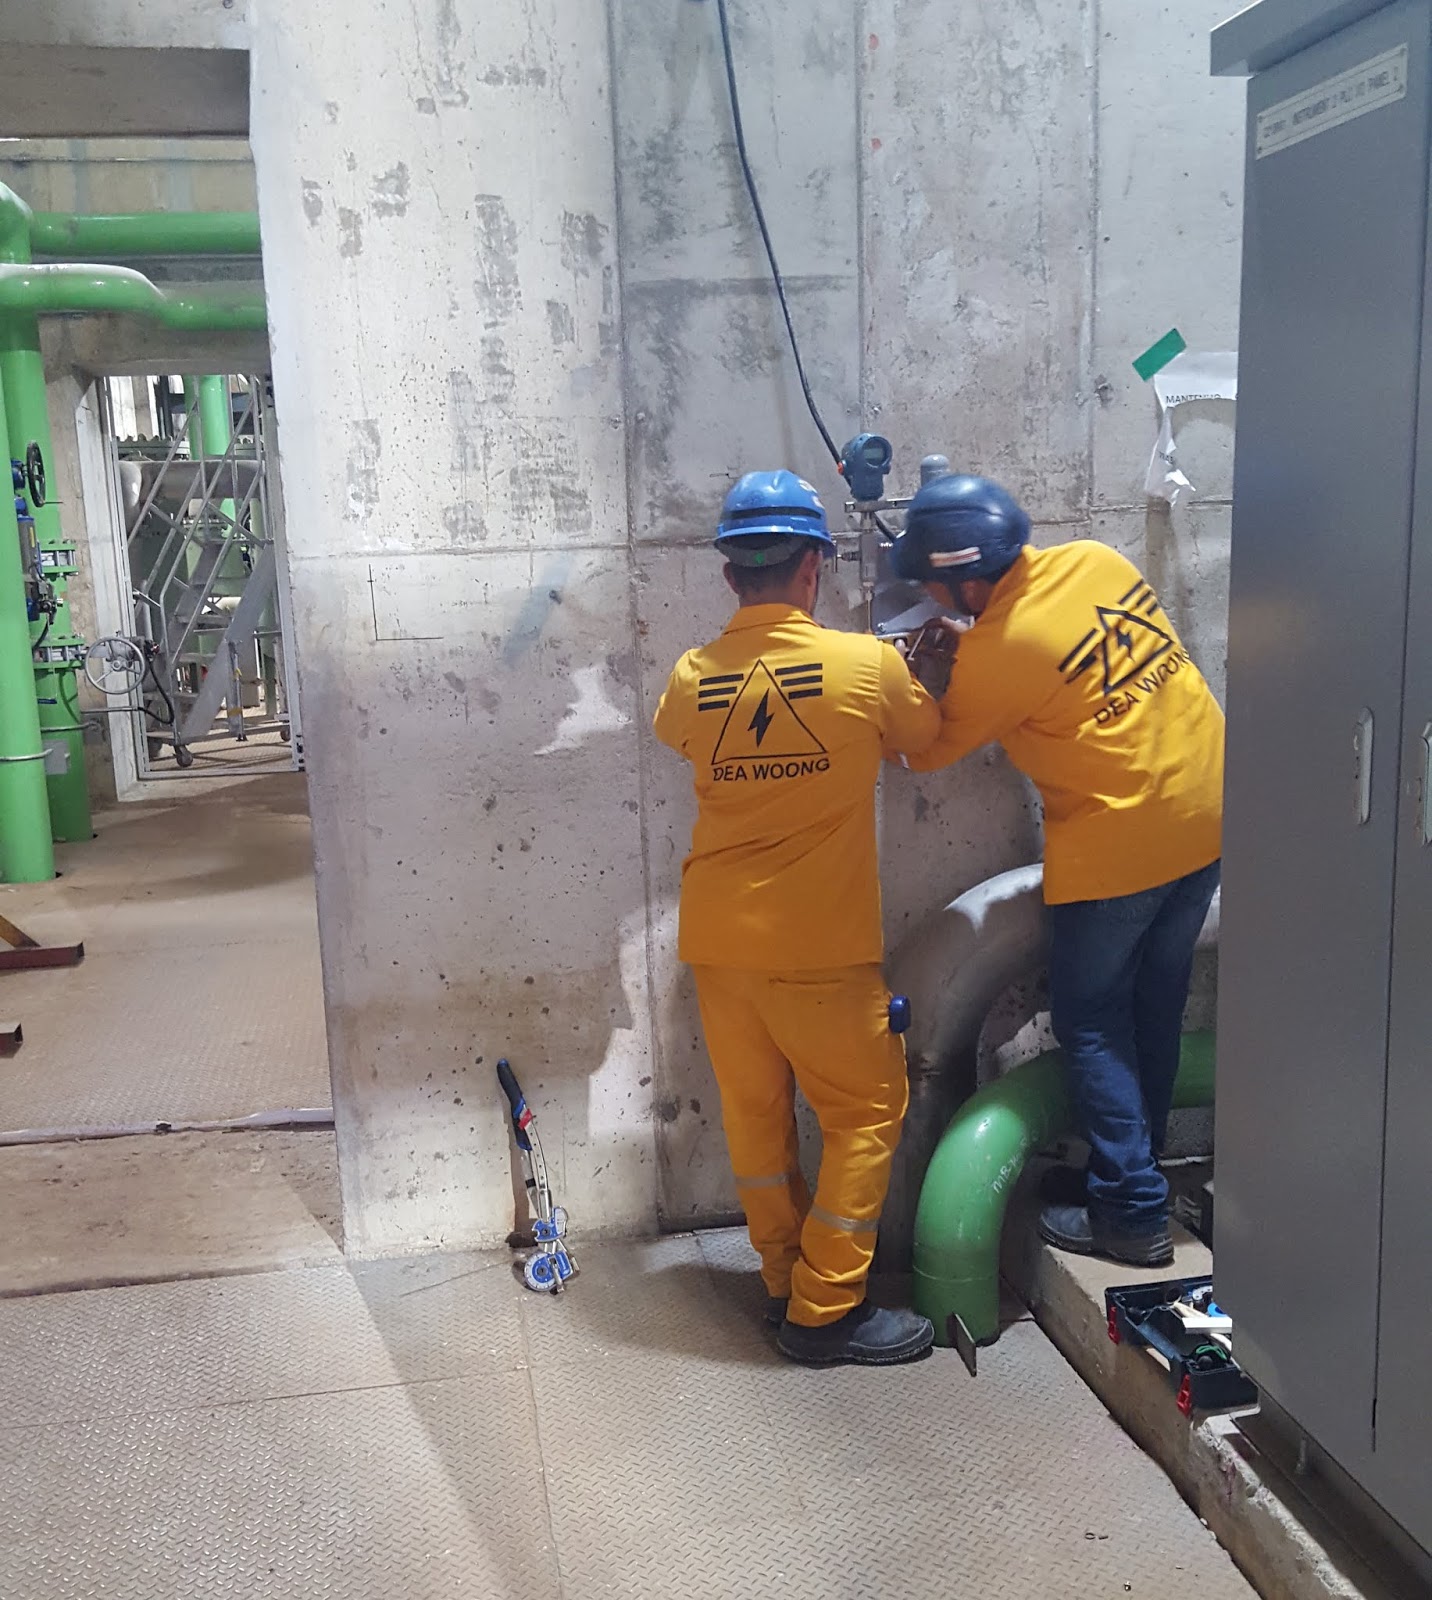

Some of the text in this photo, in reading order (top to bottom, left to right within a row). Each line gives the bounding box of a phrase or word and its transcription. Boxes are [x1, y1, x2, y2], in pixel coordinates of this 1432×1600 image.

[1093, 690, 1142, 724] DEA
[713, 758, 831, 782] DEA WOONG
